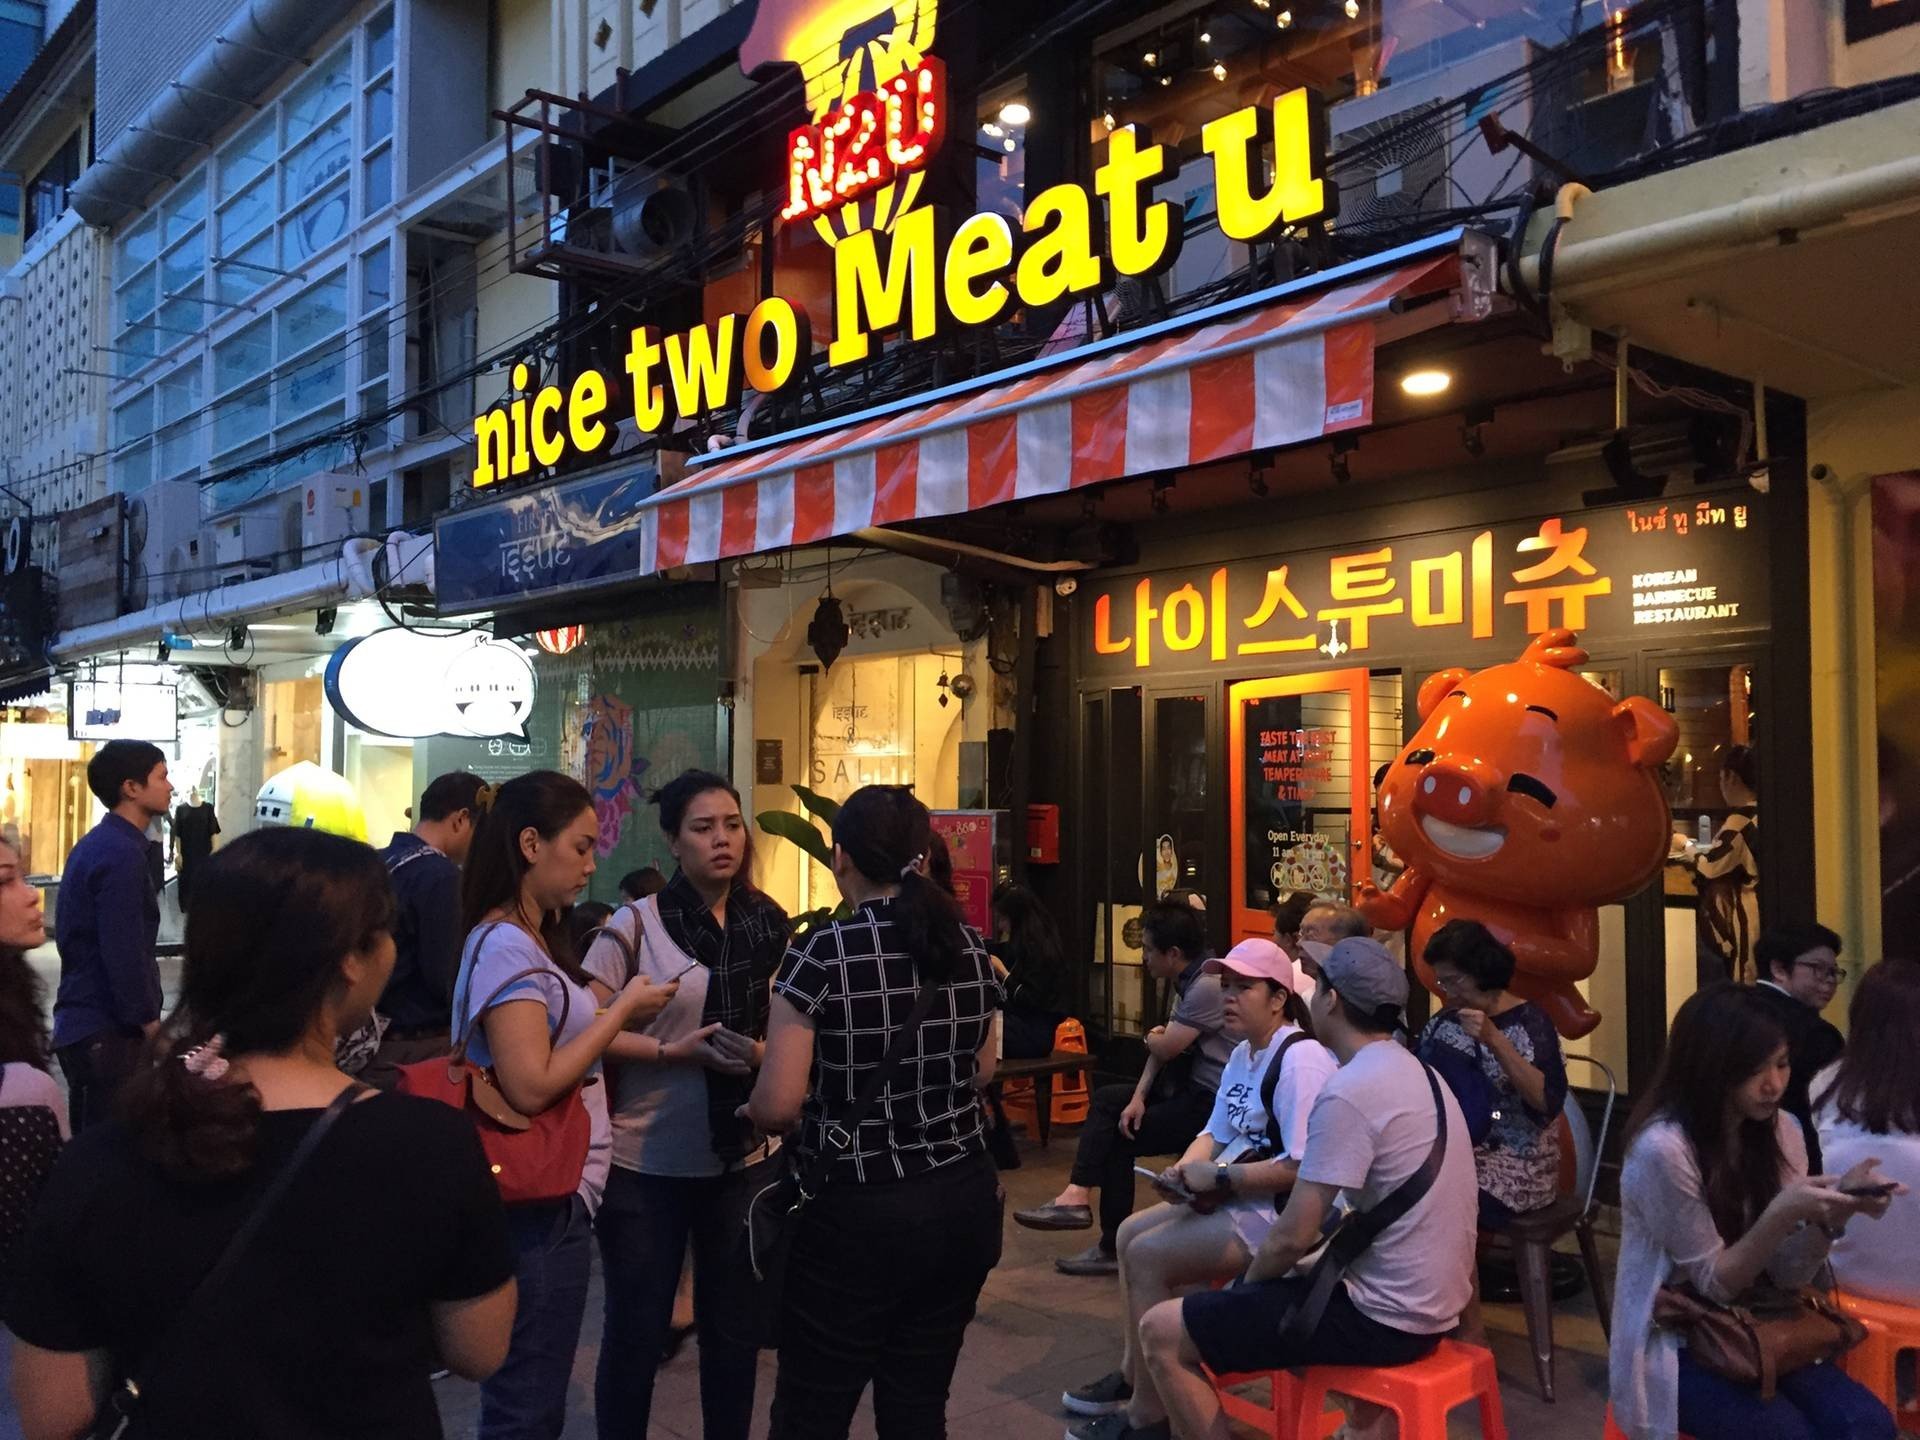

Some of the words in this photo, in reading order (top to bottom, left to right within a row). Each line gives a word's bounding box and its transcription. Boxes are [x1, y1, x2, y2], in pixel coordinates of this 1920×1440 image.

[782, 60, 944, 221] N2U
[473, 363, 607, 488] nice
[625, 297, 797, 433] two
[829, 124, 1167, 367] Meat
[1203, 87, 1324, 240] u
[1632, 568, 1697, 588] KOREAN
[1095, 518, 1612, 667] 나이스투미츄
[1633, 586, 1717, 607] BARBECUE
[1633, 603, 1739, 625] RESTAURANT
[1260, 731, 1288, 745] TASTE
[1263, 750, 1288, 763] MEAT
[1264, 767, 1332, 782] TEMPERATURE
[1268, 830, 1288, 843] Open
[1290, 830, 1330, 847] Everyday
[1226, 1083, 1254, 1104] BE
